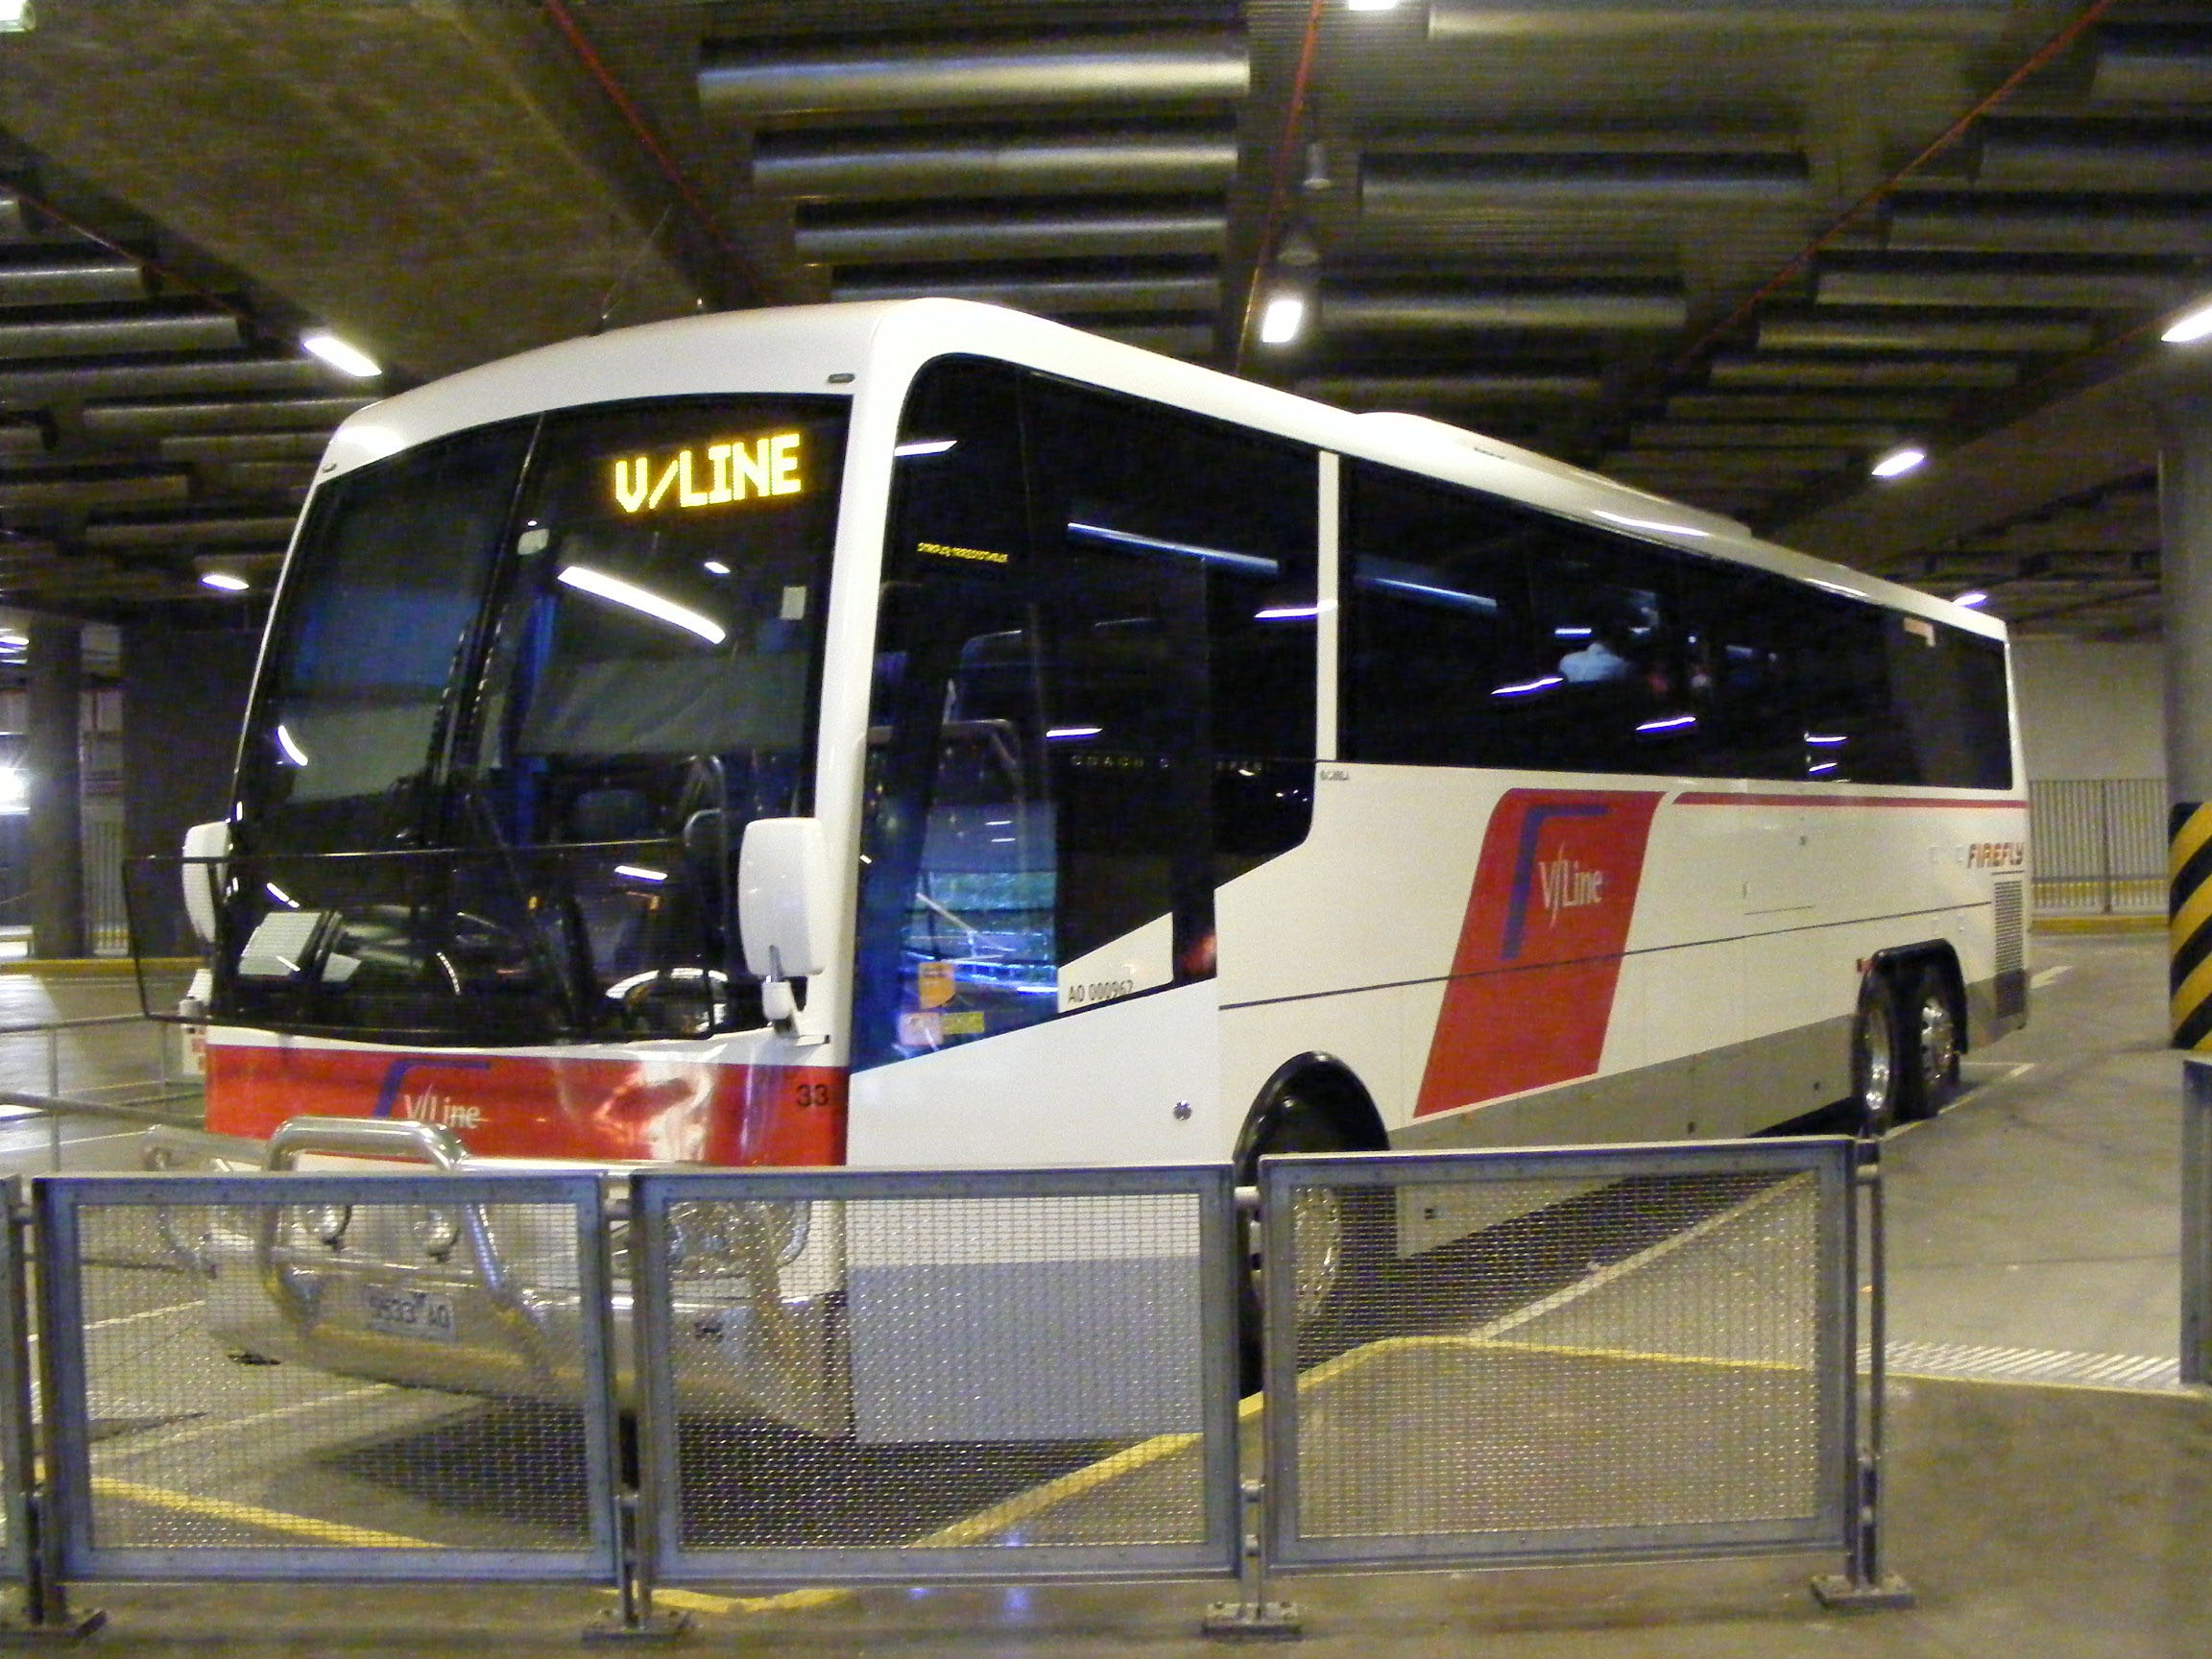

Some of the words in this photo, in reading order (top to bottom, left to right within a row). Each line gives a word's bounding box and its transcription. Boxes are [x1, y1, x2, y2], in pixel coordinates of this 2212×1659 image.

[614, 433, 802, 514] V/LINE
[1966, 842, 2025, 869] FIREFLY
[798, 1083, 829, 1107] 33
